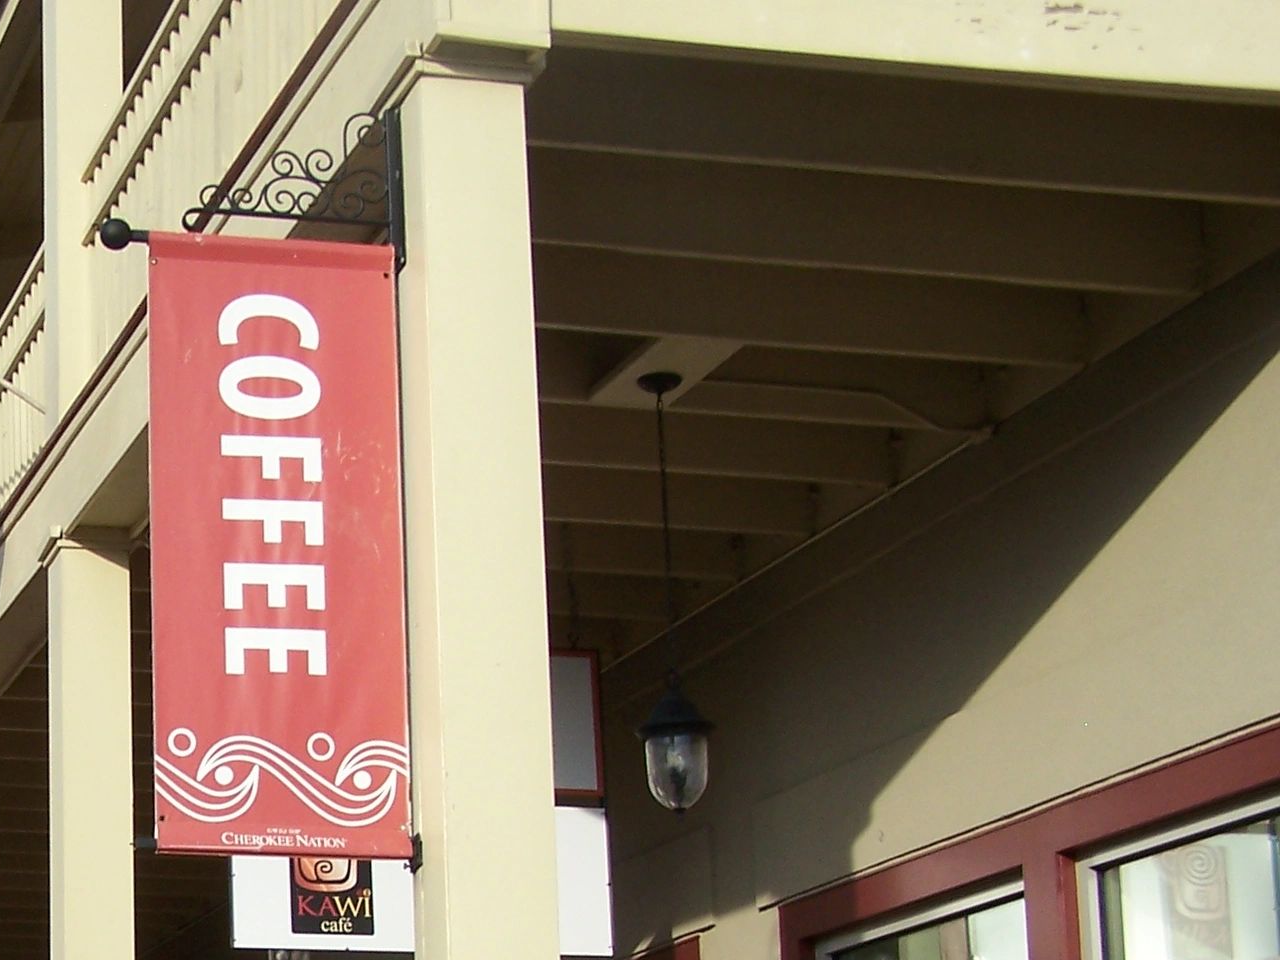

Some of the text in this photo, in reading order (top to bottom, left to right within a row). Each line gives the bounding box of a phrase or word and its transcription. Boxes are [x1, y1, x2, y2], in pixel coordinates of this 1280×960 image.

[218, 294, 327, 676] COFFEE
[221, 831, 347, 849] CHEROKEE NATION
[320, 917, 353, 933] café
